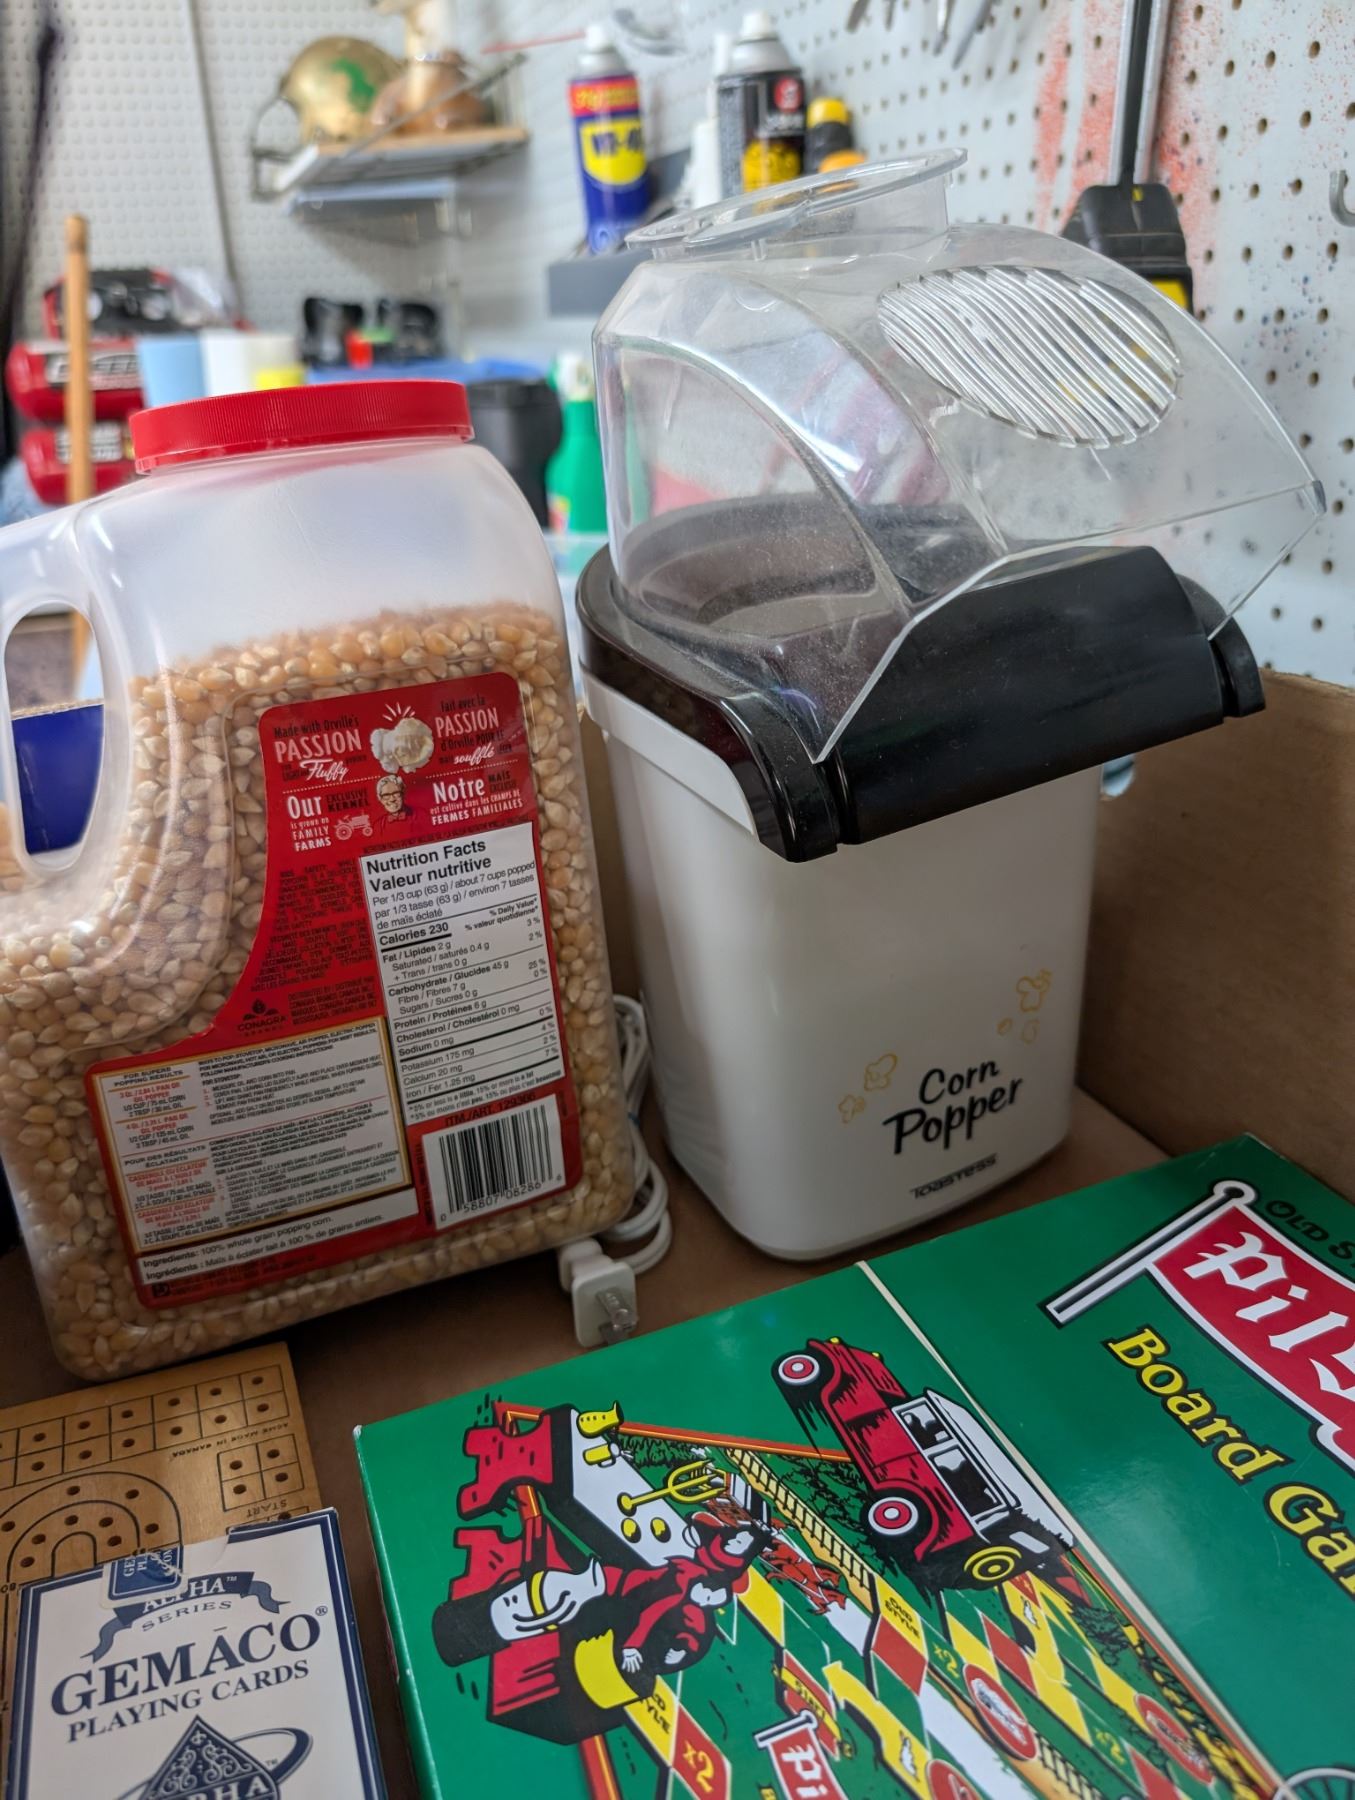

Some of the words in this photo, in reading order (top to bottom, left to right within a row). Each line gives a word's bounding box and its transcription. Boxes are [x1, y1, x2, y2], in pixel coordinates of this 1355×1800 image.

[434, 706, 499, 738] PASSION
[274, 728, 362, 763] PASSION
[299, 758, 349, 782] Fluffy
[432, 777, 486, 805] Notre
[287, 795, 323, 819] Our
[327, 799, 369, 812] KERNEL
[431, 809, 470, 826] FERMES
[472, 797, 524, 818] FAMILIALES
[292, 825, 330, 841] FAMILY
[294, 836, 332, 852] FARMS
[366, 850, 439, 875] Nutrition
[443, 838, 486, 860] Facts
[369, 872, 423, 893] Valeur
[427, 856, 492, 881] nutritive
[372, 895, 389, 907] Per
[406, 889, 423, 900] cup
[455, 875, 480, 889] about
[486, 868, 507, 882] cups
[506, 860, 535, 878] popped
[374, 910, 391, 921] par
[409, 898, 434, 912] tasse
[468, 883, 500, 898] environ
[508, 873, 535, 888] tasses
[376, 920, 390, 931] de
[379, 928, 427, 946] Calories
[428, 920, 449, 936] 230
[382, 953, 398, 965] Fat
[403, 943, 437, 959] Lipides
[392, 955, 433, 972] Saturated
[388, 976, 448, 997] Carbohydrate
[454, 964, 491, 981] Glucides
[401, 967, 426, 980] Trans
[431, 960, 453, 972] trans
[397, 993, 420, 1005] Fibre
[426, 985, 452, 998] Fibres
[399, 1000, 430, 1015] Sugars
[435, 992, 464, 1006] Sucres
[394, 1016, 427, 1030] Protein
[432, 1004, 473, 1021] Protéines
[396, 1024, 446, 1044] Cholesterol
[452, 1009, 500, 1029] Cholestérol
[399, 1041, 432, 1057] Sodium
[401, 1055, 444, 1073] Potassium
[461, 1047, 475, 1057] mg
[403, 1070, 437, 1086] Calcium
[918, 1059, 1000, 1105] Corn
[405, 1087, 421, 1099] Iron
[881, 1077, 1024, 1156] Popper
[1264, 1200, 1330, 1242] OLD
[143, 1249, 200, 1269] Ingredients:
[276, 1220, 311, 1239] popping
[1104, 1325, 1290, 1483] Board
[1266, 1482, 1355, 1598] Ga
[246, 1499, 287, 1518] START
[141, 1600, 233, 1632] SERIES
[67, 1688, 201, 1744] PLAYING
[210, 1659, 310, 1702] CARDS
[682, 1739, 715, 1794] x2
